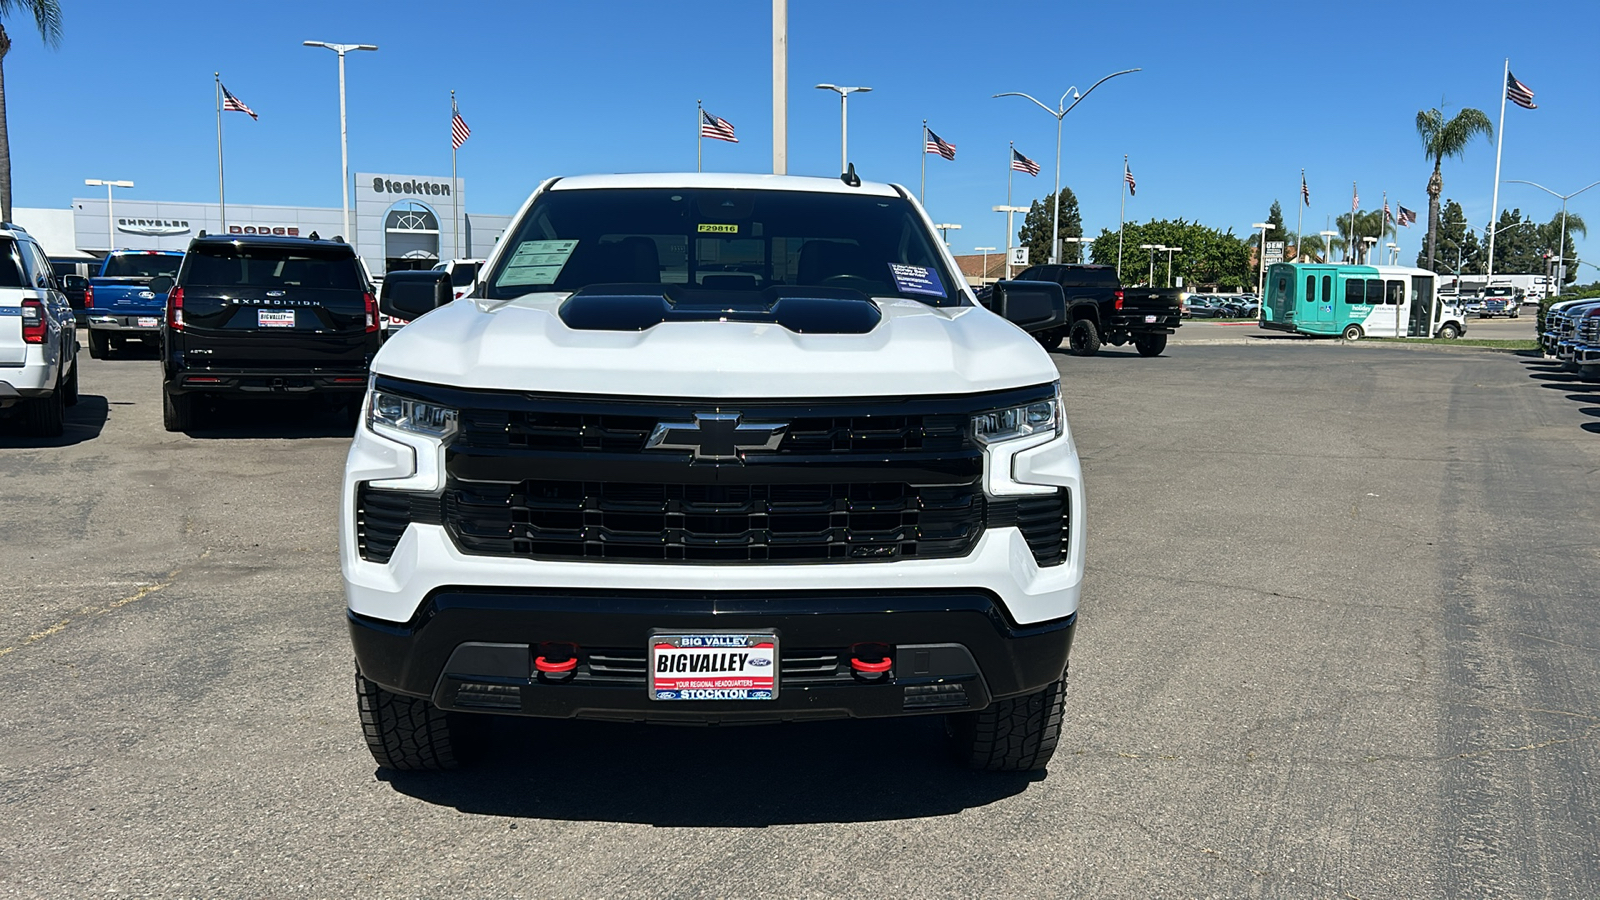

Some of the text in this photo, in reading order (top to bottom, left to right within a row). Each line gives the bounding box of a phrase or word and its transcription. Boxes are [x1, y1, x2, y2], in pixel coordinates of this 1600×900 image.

[373, 177, 451, 196] Stockton
[118, 218, 189, 228] CHRYSLER
[229, 225, 299, 236] DODGE
[681, 637, 748, 646] BIG VALLEY
[656, 653, 768, 673] BIGVALLEY Ford
[690, 680, 714, 688] REGIONAL
[680, 689, 748, 699] STOCKTON
